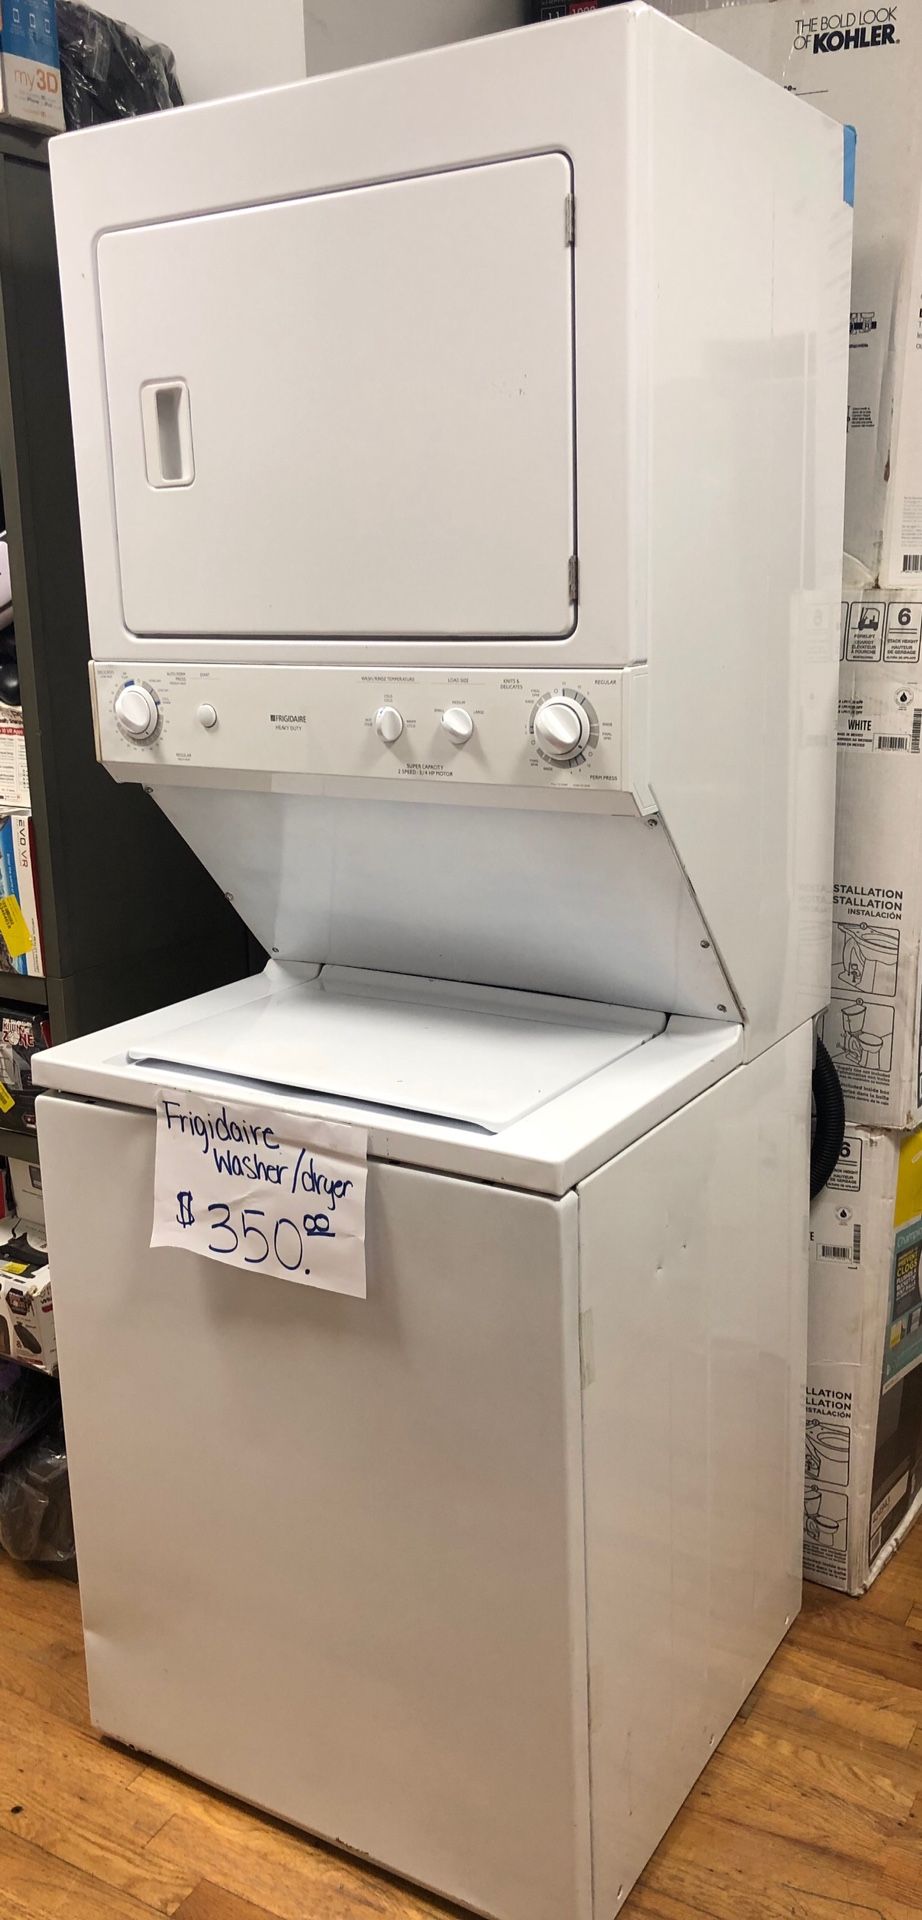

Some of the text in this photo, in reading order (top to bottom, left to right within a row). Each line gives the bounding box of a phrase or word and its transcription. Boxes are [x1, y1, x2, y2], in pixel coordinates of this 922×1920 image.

[794, 6, 898, 34] THE BOLD LOOK
[793, 35, 812, 50] OF
[898, 608, 912, 626] 6
[275, 714, 307, 723] FRIGIDAIRE
[848, 719, 872, 731] WHITE
[18, 819, 29, 868] EVO VR
[833, 884, 903, 899] STALLATION
[847, 908, 902, 920] INSTALACIÓN
[162, 1100, 280, 1153] Frigidaire
[841, 1141, 851, 1158] 6
[806, 1386, 852, 1400] LLATION
